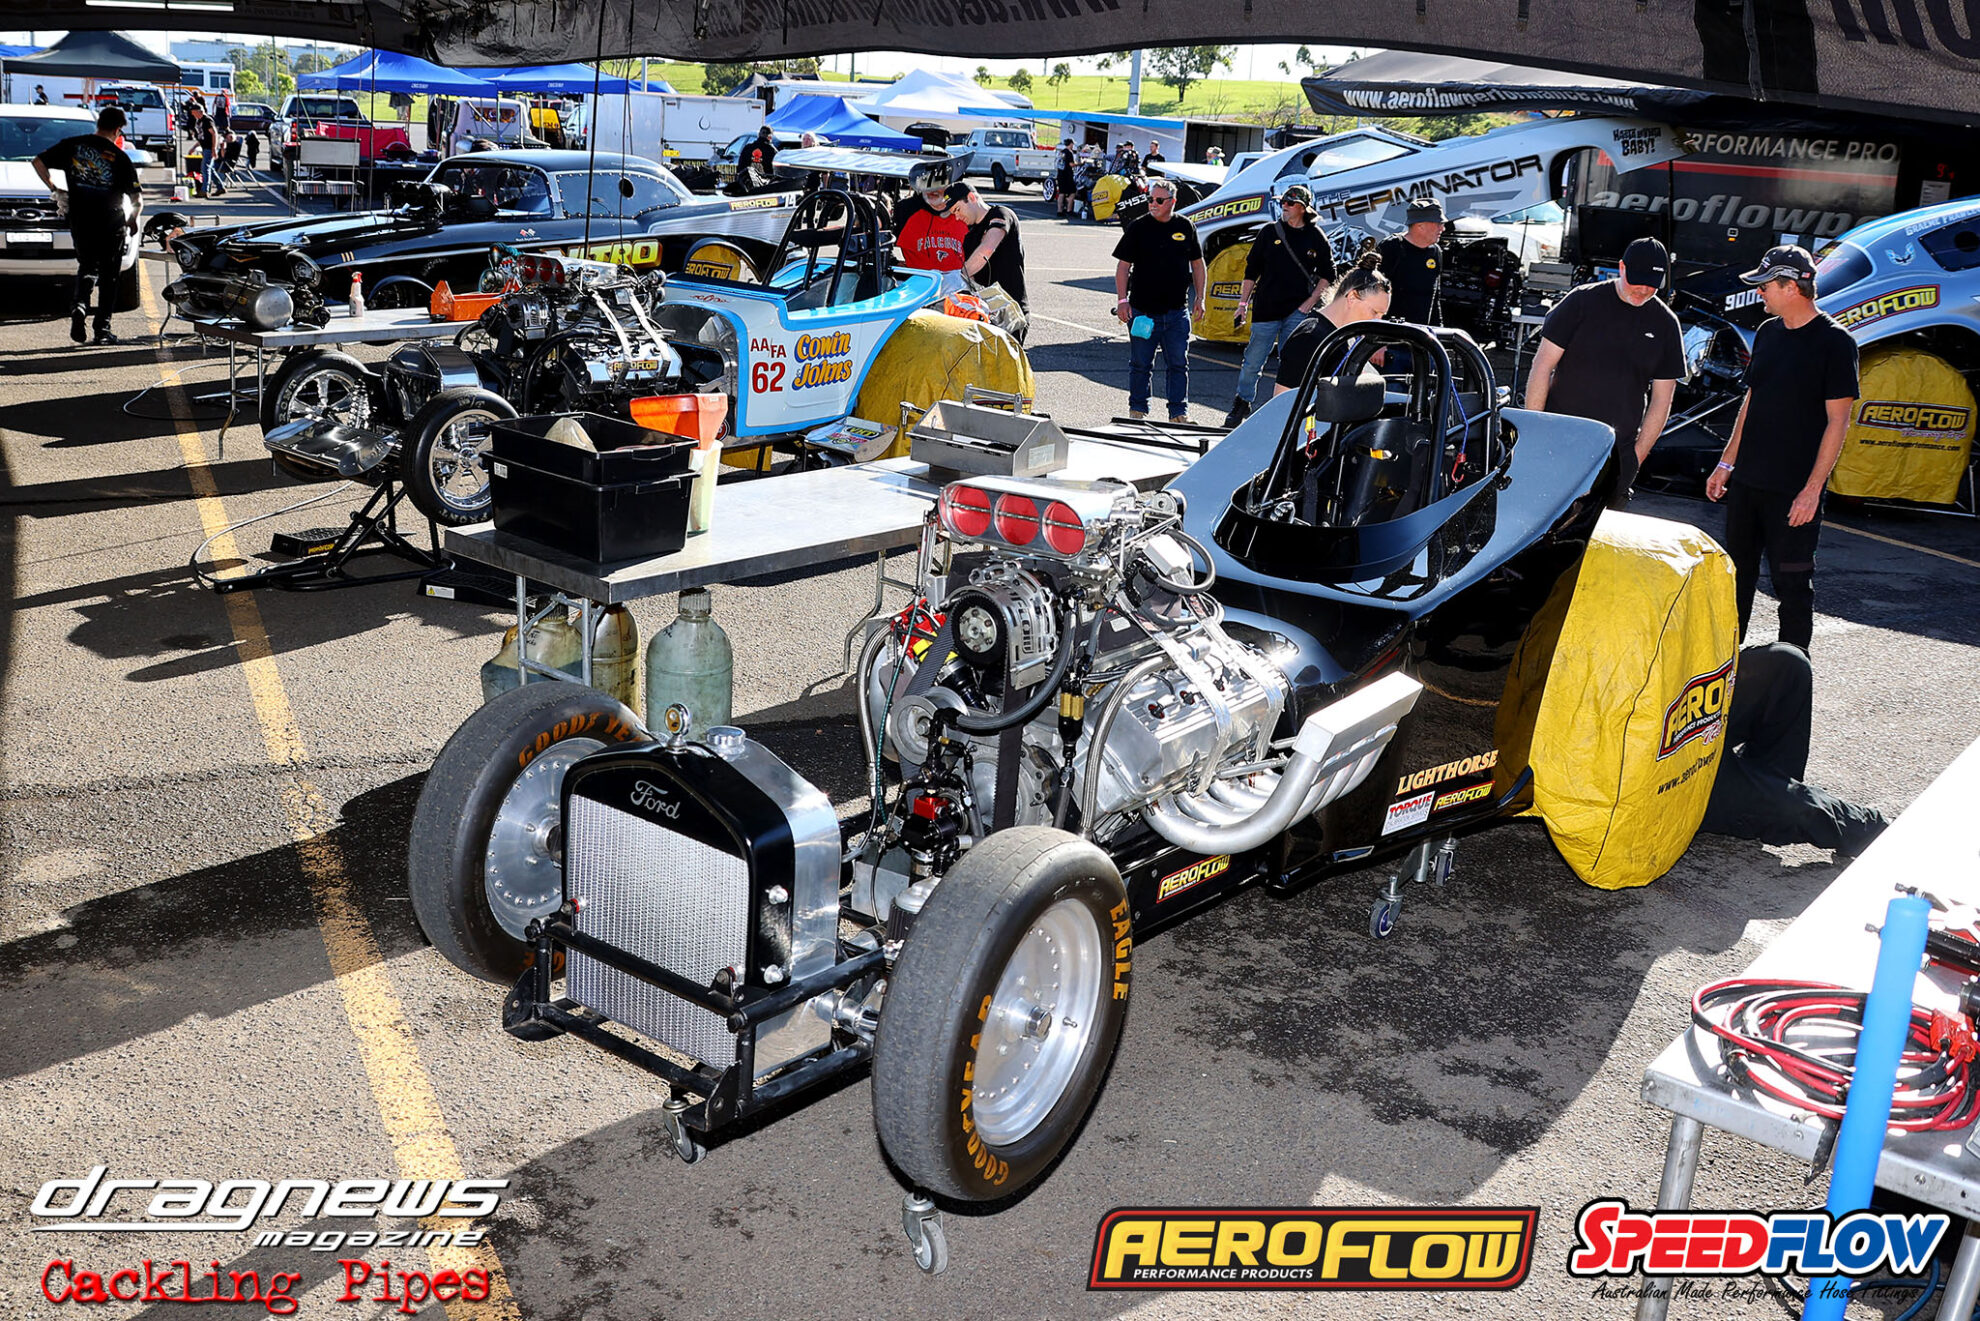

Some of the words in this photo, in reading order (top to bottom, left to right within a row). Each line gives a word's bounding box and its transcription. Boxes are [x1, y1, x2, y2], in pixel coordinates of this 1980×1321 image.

[1621, 138, 1656, 157] BABY!
[731, 197, 779, 211] AEROFLOW
[1319, 154, 1544, 222] TERMINATOR
[1190, 196, 1263, 223] AEROFLOW
[917, 236, 963, 254] FALCONS
[794, 331, 851, 363] Cowin
[752, 361, 786, 394] 62
[792, 359, 853, 391] Johns
[1862, 405, 1967, 430] AEROFLOW
[1396, 750, 1500, 797] LIGHTHORSE
[629, 779, 681, 820] Ford
[1389, 794, 1433, 820] TORQUE
[1434, 782, 1494, 812] AEROFLOW
[1158, 854, 1231, 900] AEROFLOW
[1109, 899, 1131, 1001] EAGLE
